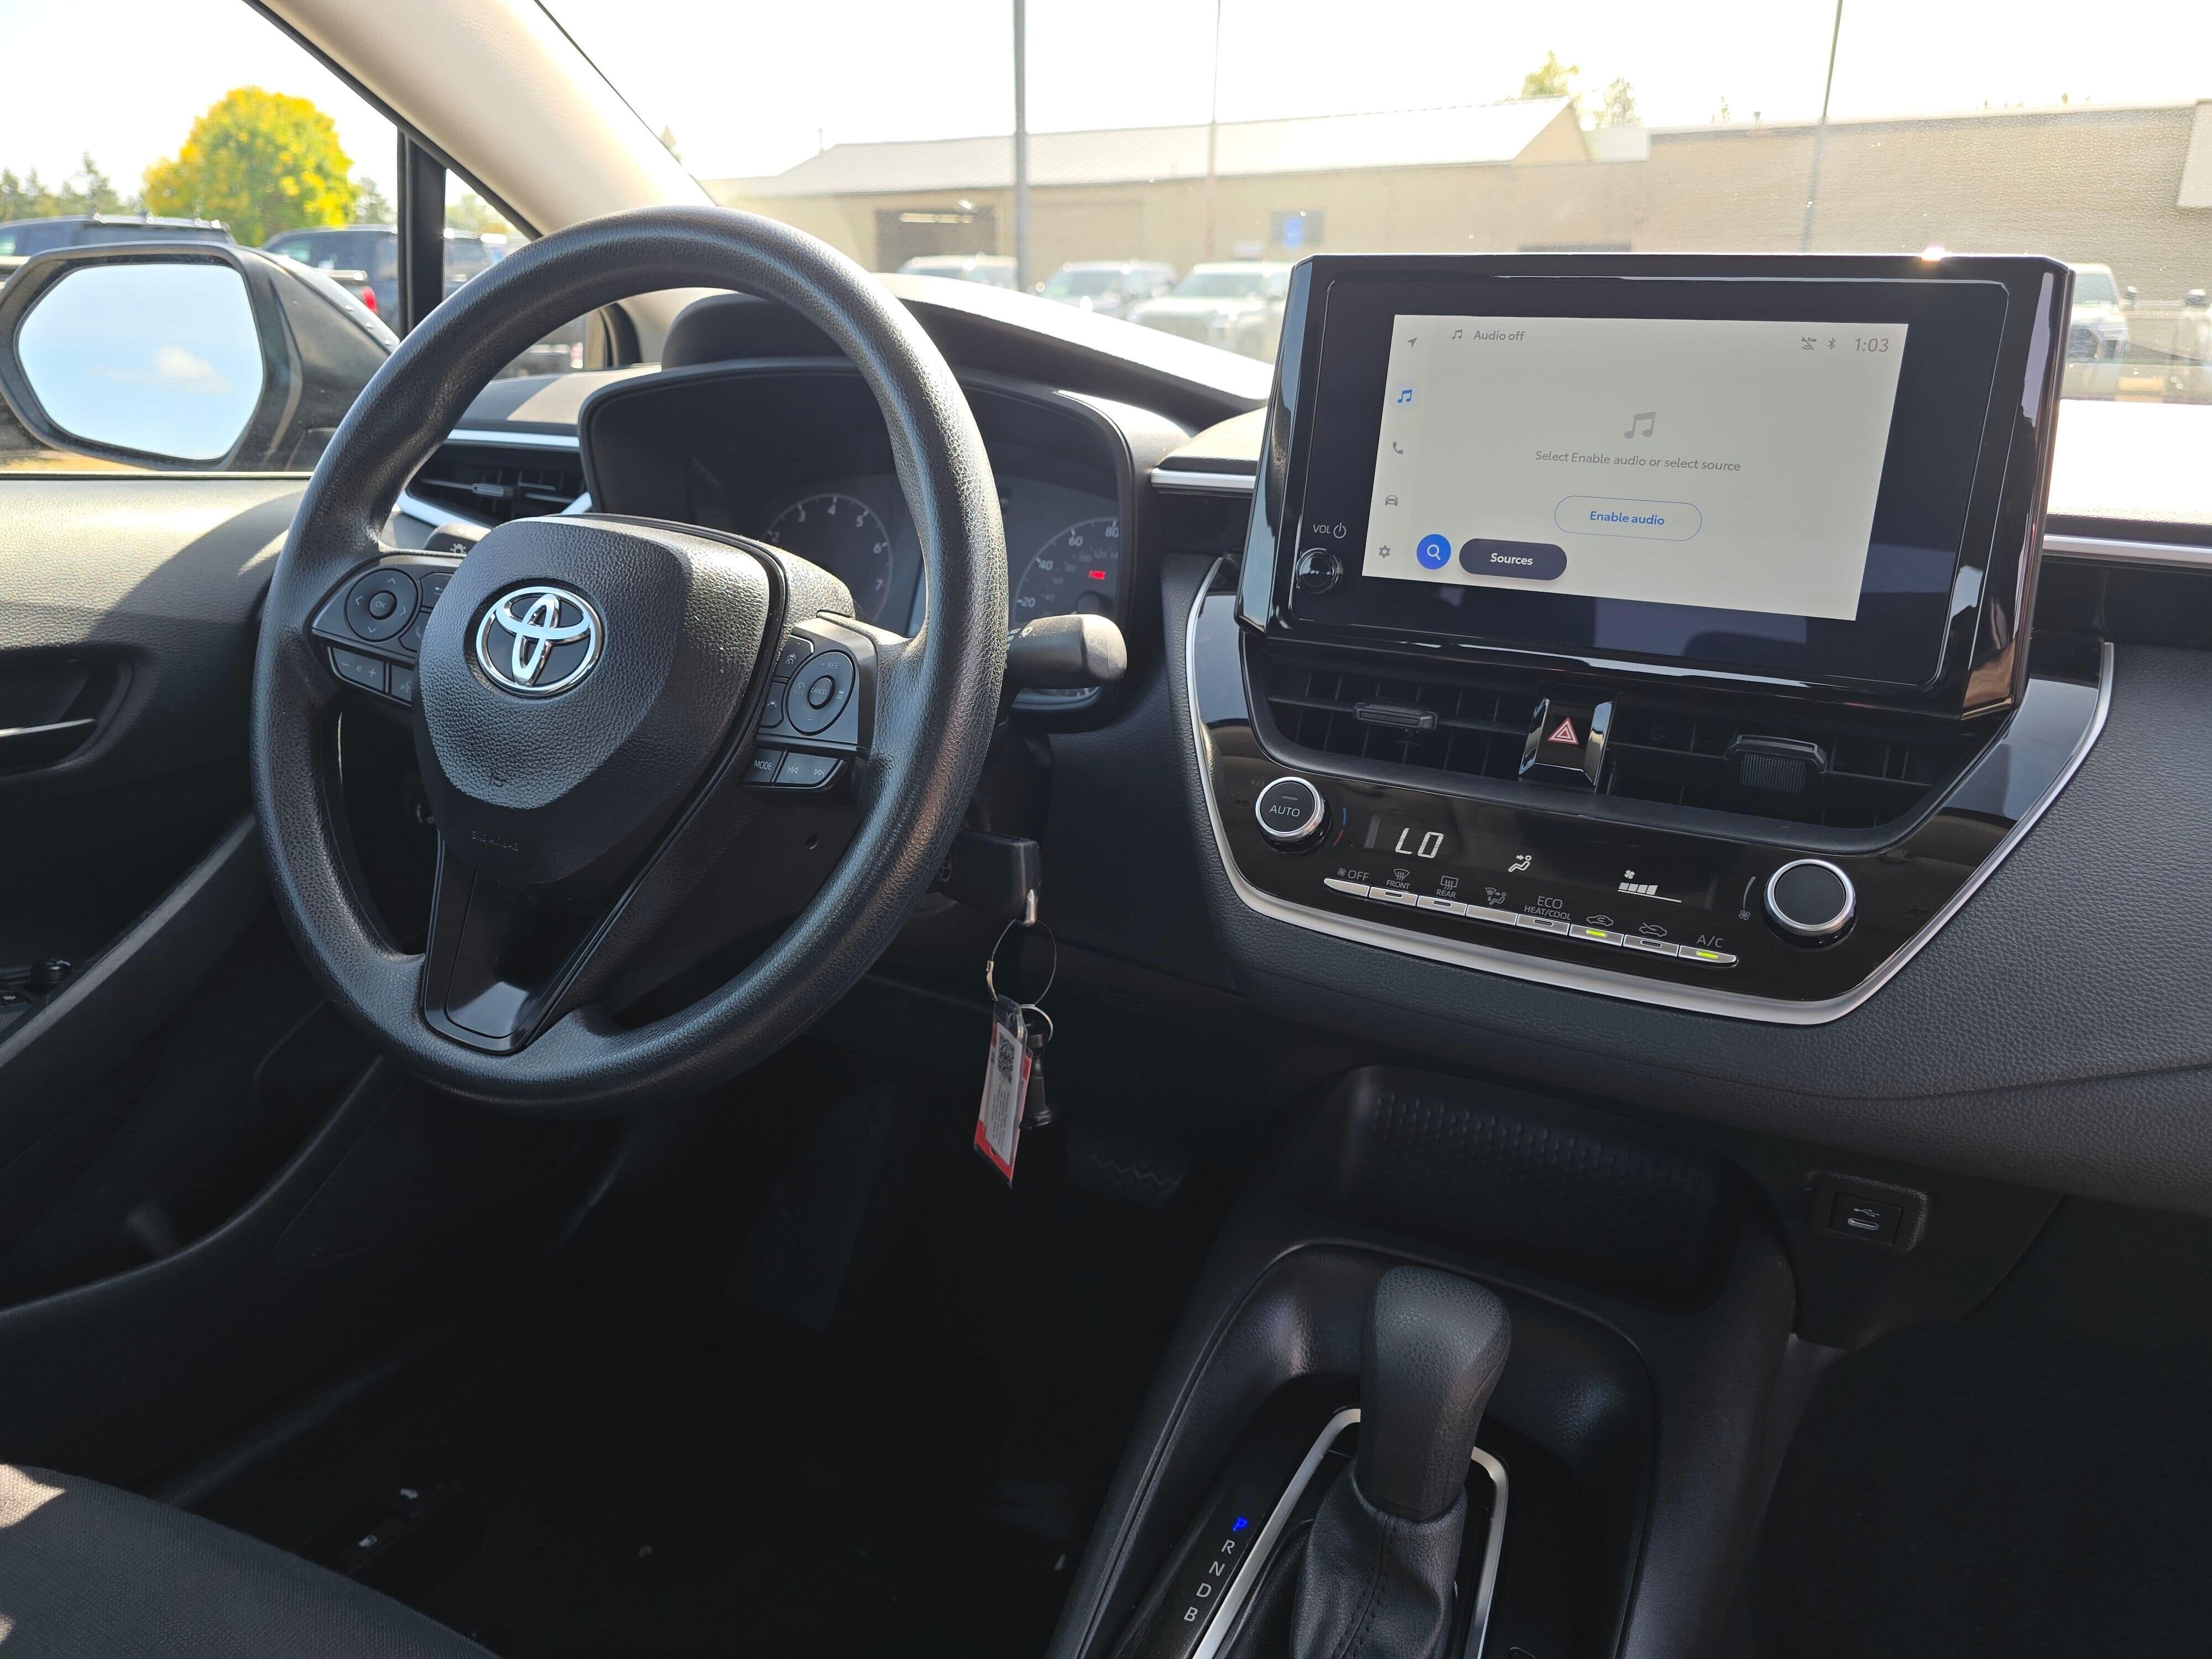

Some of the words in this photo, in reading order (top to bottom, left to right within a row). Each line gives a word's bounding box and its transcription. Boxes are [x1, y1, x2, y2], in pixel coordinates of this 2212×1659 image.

[1473, 330, 1506, 341] Audio
[1508, 330, 1525, 341] off
[1854, 337, 1890, 352] 1:03
[1535, 450, 1569, 462] Select
[1571, 452, 1611, 464] Enable
[1613, 455, 1646, 466] audio
[1664, 457, 1699, 469] select
[1701, 462, 1741, 471] source
[855, 514, 864, 527] 5
[1590, 510, 1629, 523] Enable
[1631, 514, 1666, 525] audio
[1104, 526, 1119, 538] 80
[1313, 524, 1331, 534] VOL
[873, 541, 882, 554] 6
[1068, 536, 1083, 546] 60
[1039, 560, 1053, 571] 40
[1490, 552, 1533, 566] Sources
[875, 578, 883, 591] 7
[1021, 597, 1036, 608] 20
[810, 687, 828, 696] CANCEL
[754, 760, 773, 770] MODE
[1269, 804, 1300, 817] AUTO
[1348, 870, 1370, 881] OFF
[1386, 879, 1411, 890] FRONT
[1436, 889, 1456, 899] REAR
[1537, 896, 1563, 910] ECO
[1524, 905, 1571, 921] HEAT/COOL
[1695, 935, 1723, 948] A/C
[1233, 1517, 1248, 1531] P
[1221, 1539, 1235, 1554] R
[1208, 1561, 1225, 1577] N
[1196, 1583, 1212, 1598] D
[1183, 1606, 1198, 1622] B
